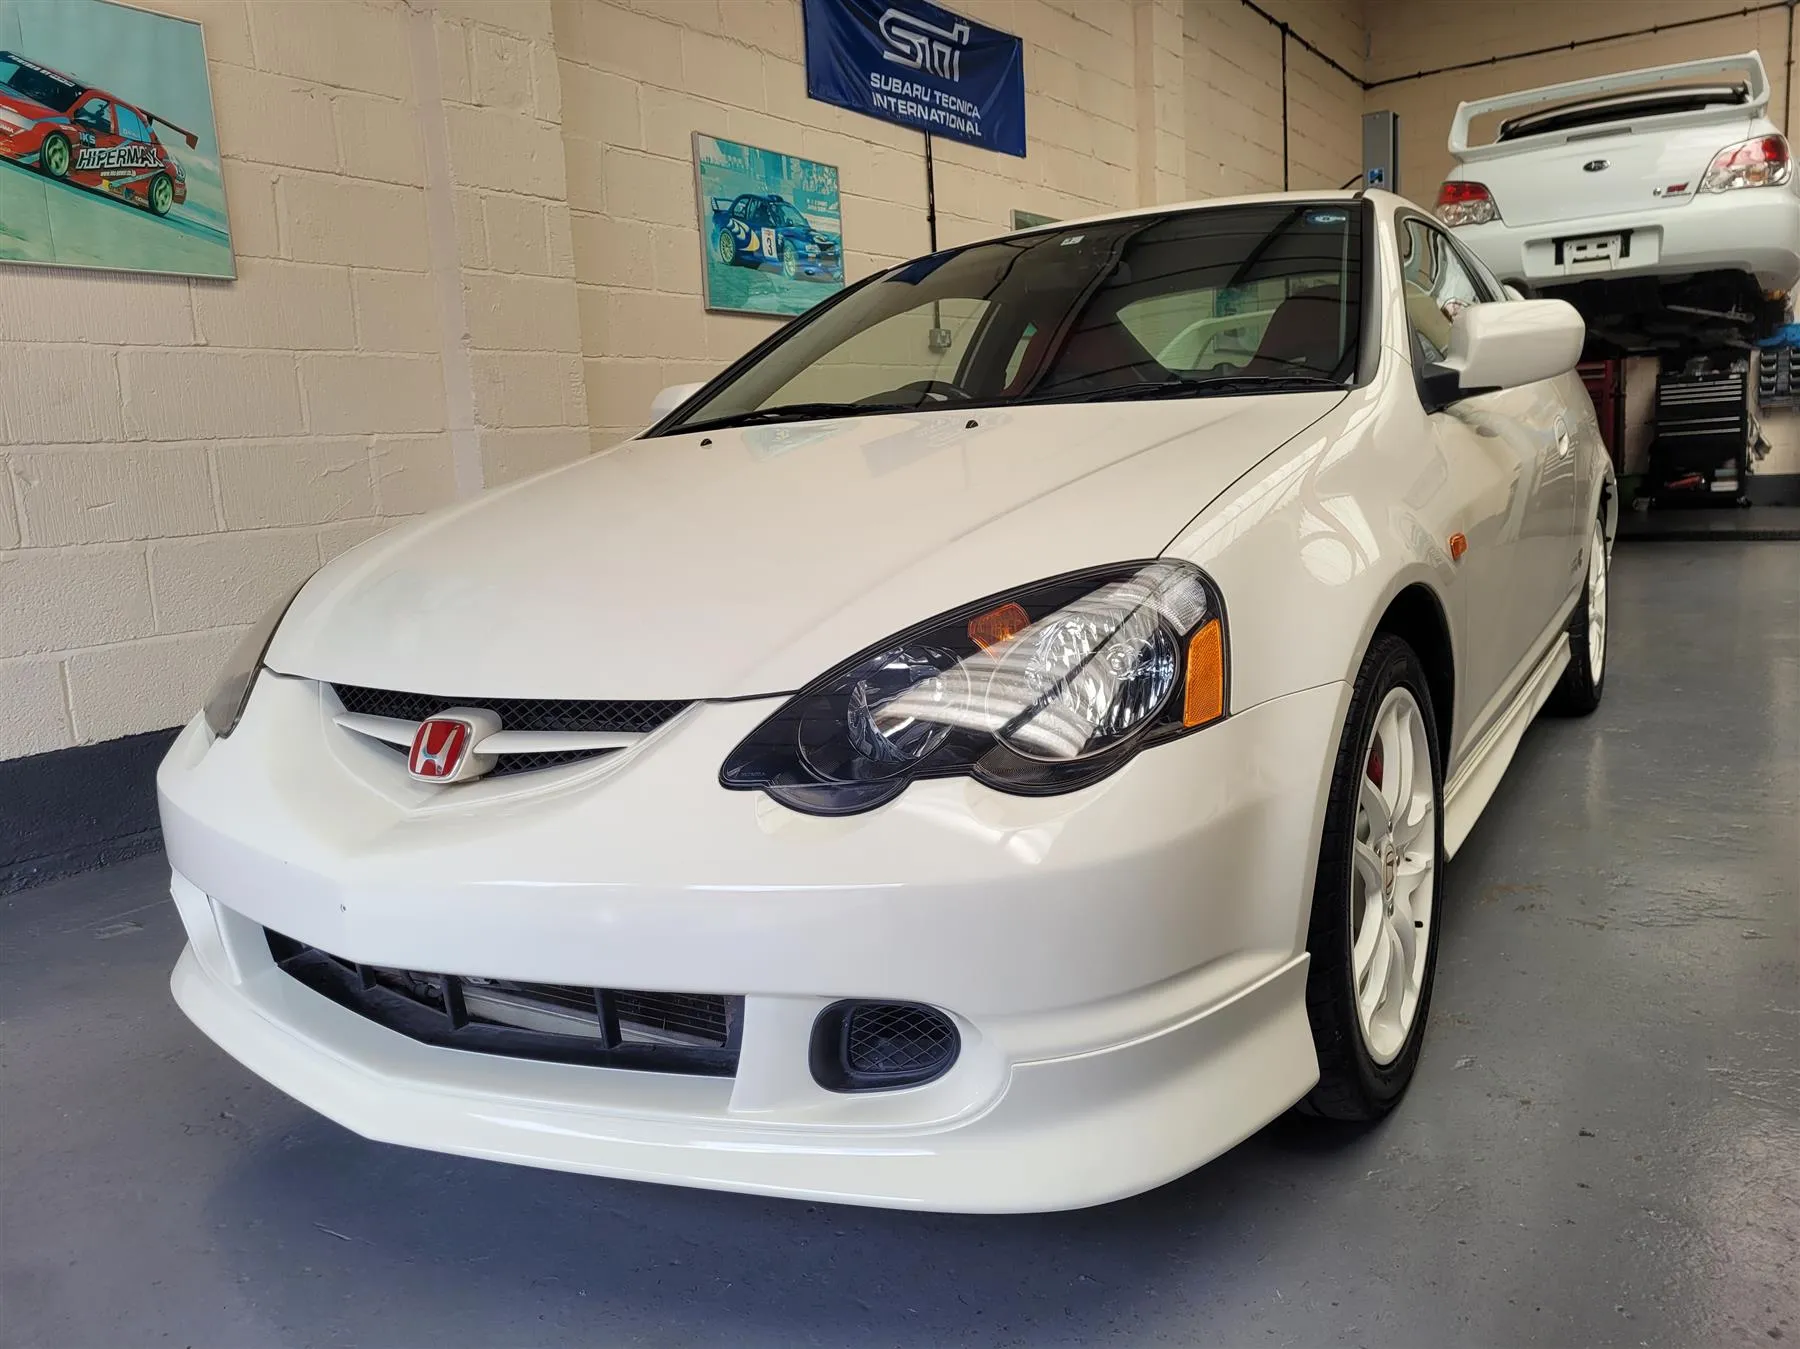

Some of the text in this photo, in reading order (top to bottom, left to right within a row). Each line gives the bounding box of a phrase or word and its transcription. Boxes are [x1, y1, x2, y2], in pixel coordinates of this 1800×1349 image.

[870, 72, 981, 118] SUBARU TECNICA
[871, 91, 982, 136] INTERNATIONAL
[75, 145, 165, 170] HIPERMAX
[766, 238, 774, 257] 3
